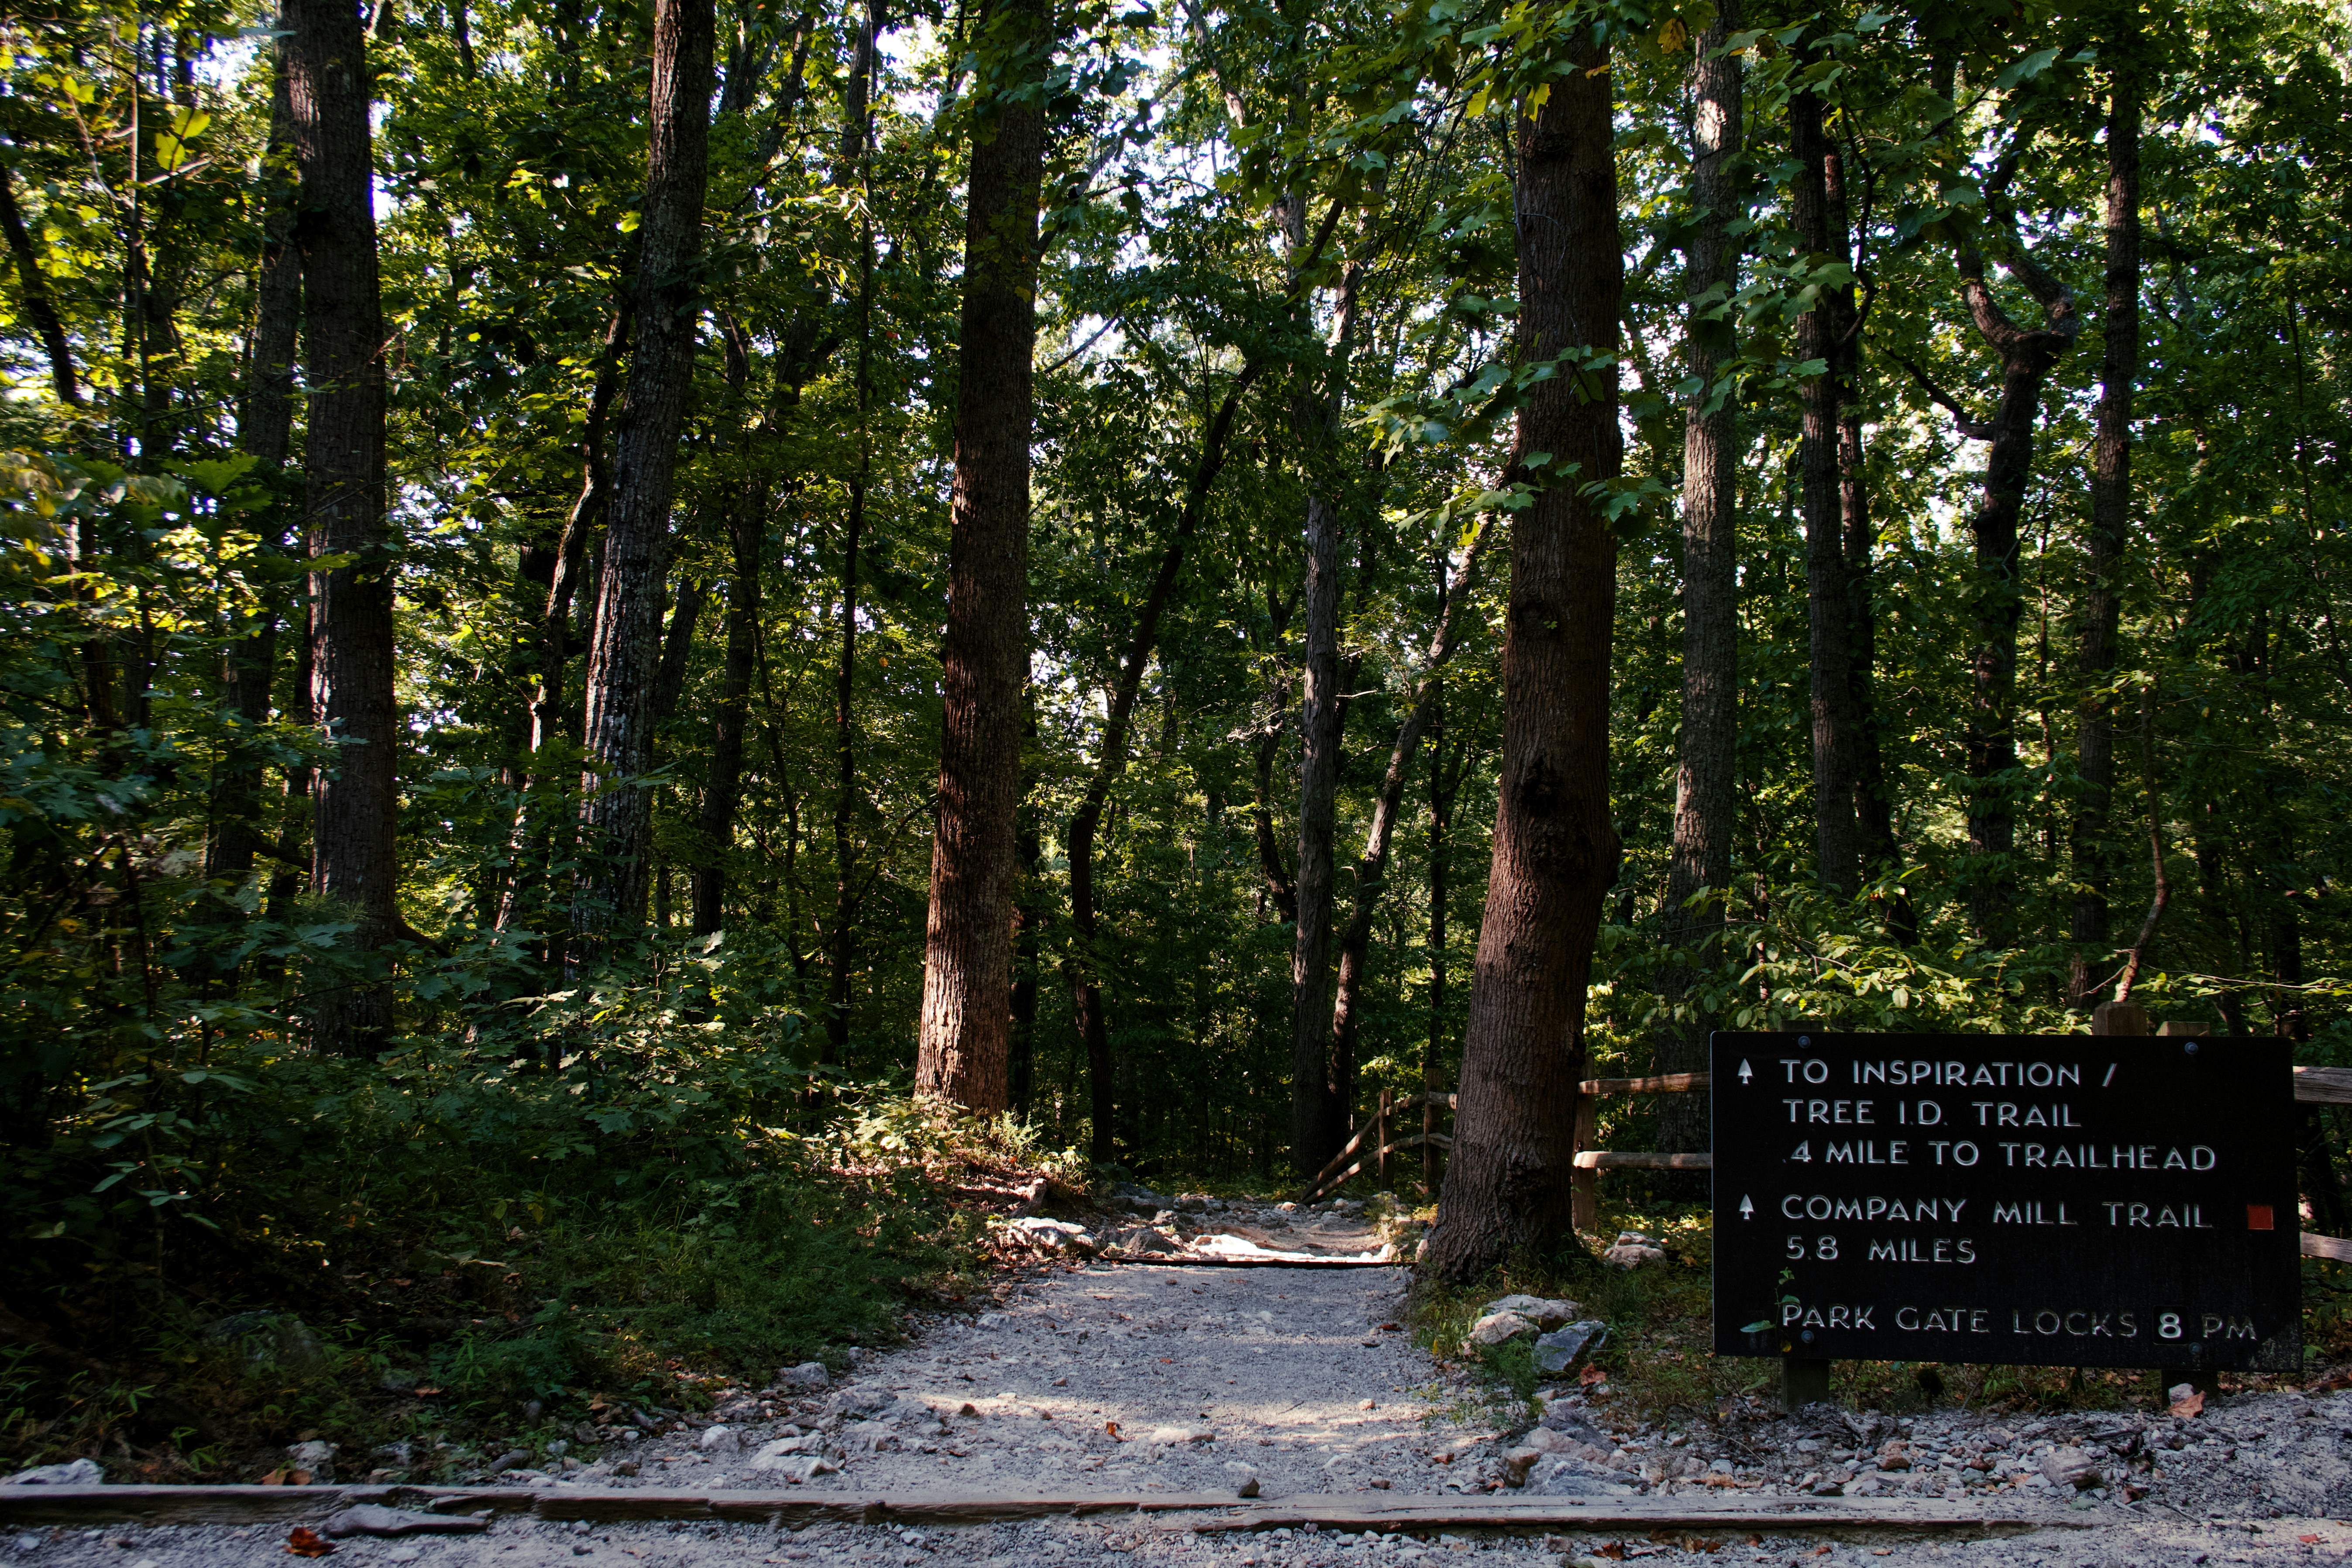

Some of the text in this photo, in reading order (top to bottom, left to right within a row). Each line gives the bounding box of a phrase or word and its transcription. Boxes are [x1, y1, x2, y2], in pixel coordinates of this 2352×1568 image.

[1779, 1059, 2117, 1087] TO INSPIRATION /
[1782, 1099, 1875, 1124] TREE
[1971, 1101, 2081, 1127] TRAIL
[1826, 1140, 1908, 1164] MILE
[1928, 1140, 1979, 1166] TO
[1999, 1142, 2215, 1170] TRAILHEAD
[1781, 1194, 2212, 1228] COMPANY MILL TRAIL
[1868, 1239, 1976, 1265] MILES
[1781, 1302, 2257, 1340] PARK GATE LOCKS 8 PM
